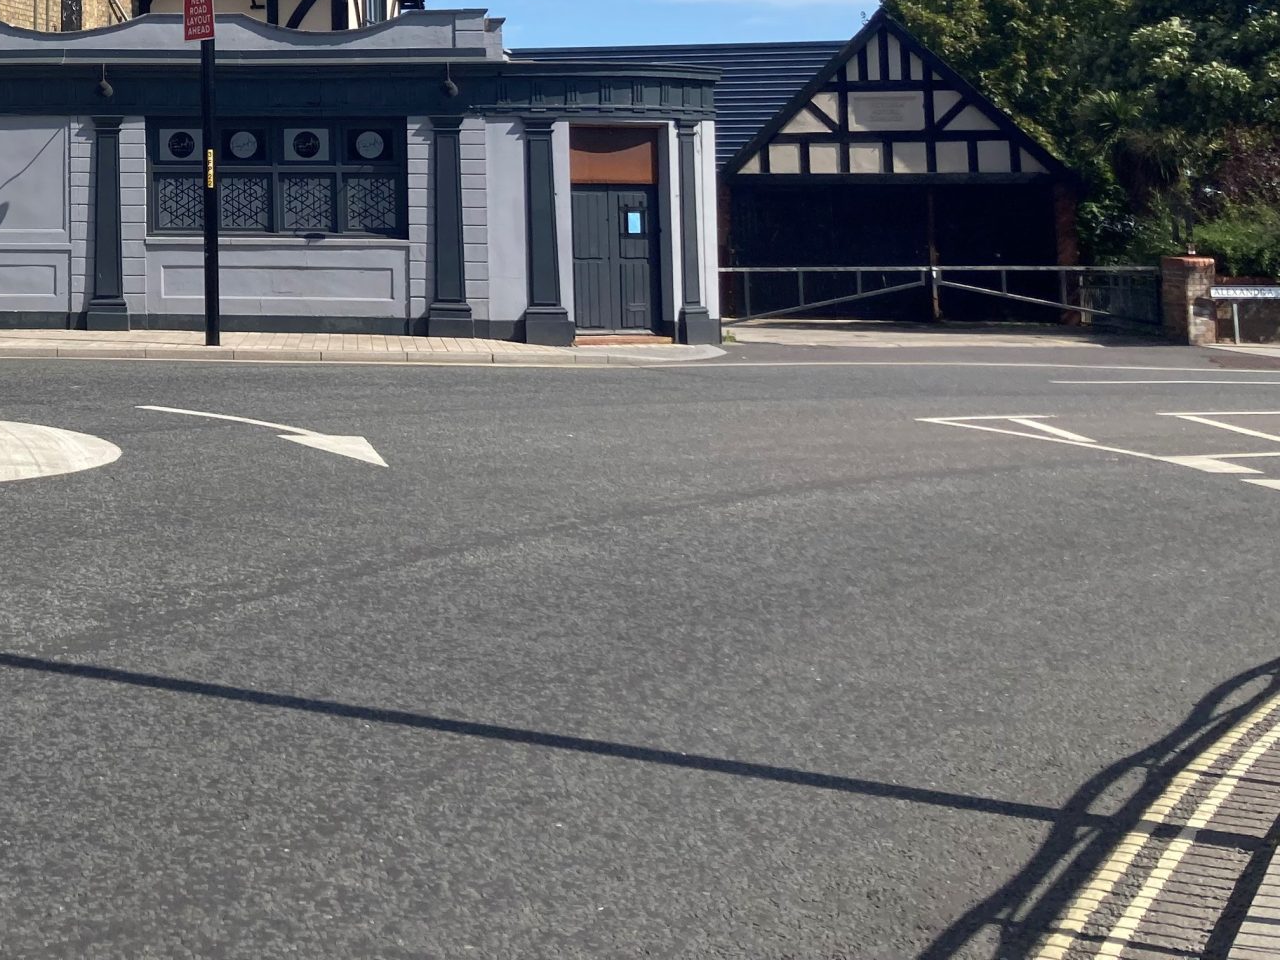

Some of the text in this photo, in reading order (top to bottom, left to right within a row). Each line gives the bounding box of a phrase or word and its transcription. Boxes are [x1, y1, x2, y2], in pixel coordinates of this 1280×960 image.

[190, 5, 207, 15] ROAD
[186, 15, 211, 26] LAYOUT
[188, 25, 210, 36] AHEAD
